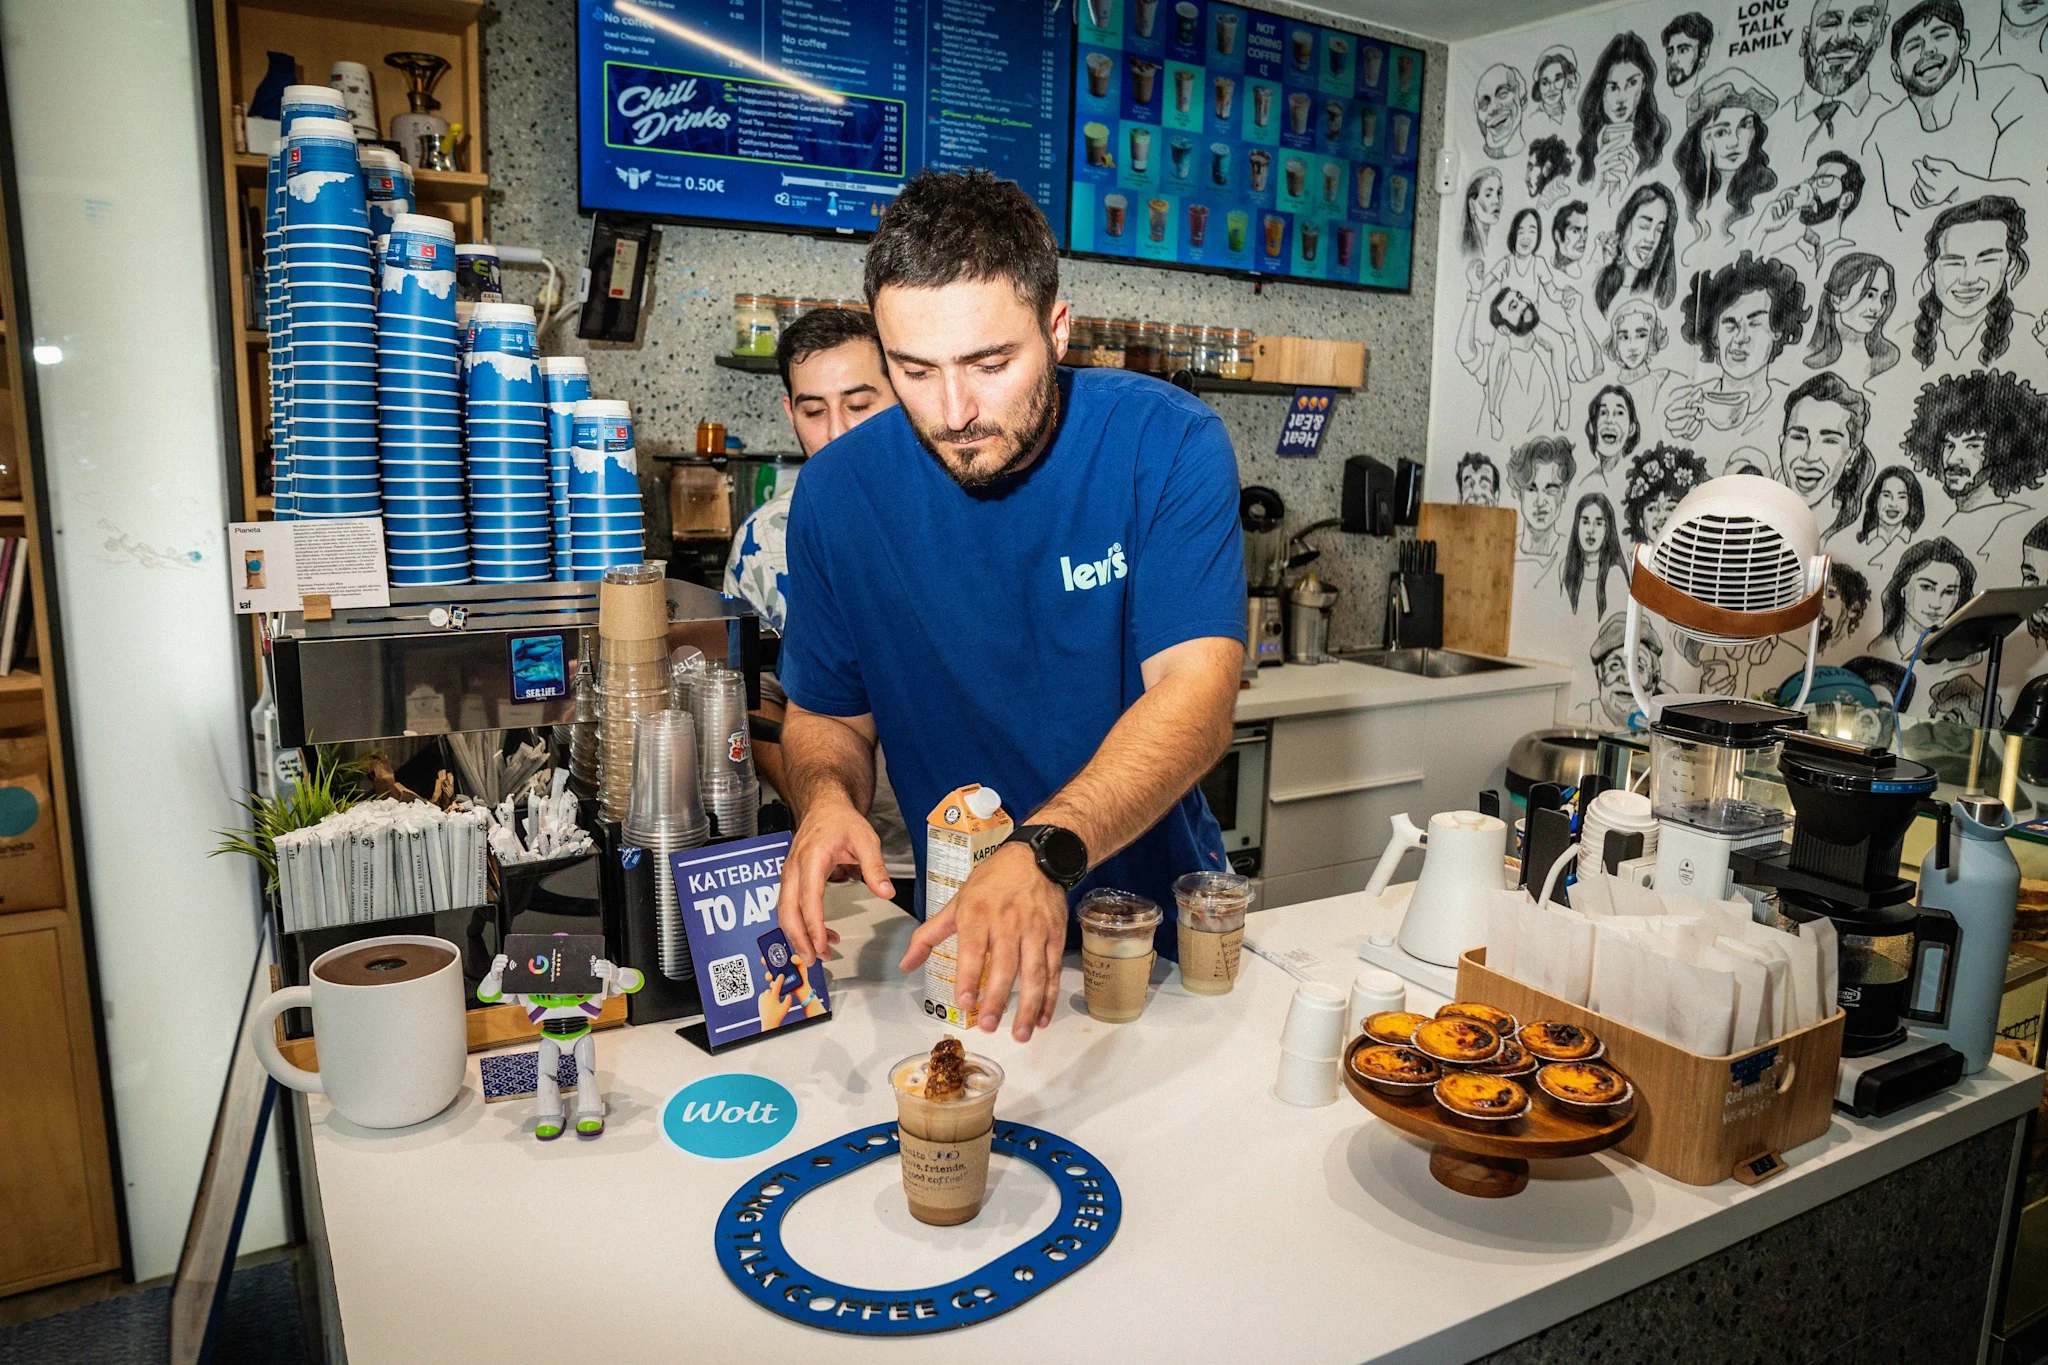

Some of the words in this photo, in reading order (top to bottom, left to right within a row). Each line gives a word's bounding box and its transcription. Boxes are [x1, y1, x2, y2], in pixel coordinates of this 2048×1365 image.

[782, 9, 798, 17] Filter
[799, 11, 819, 20] coffee
[1738, 0, 1789, 20] LONG
[604, 12, 620, 24] No
[1739, 12, 1786, 37] TALK
[782, 20, 798, 29] Filter
[799, 23, 818, 32] coffee
[954, 26, 970, 34] Latte
[1256, 22, 1276, 36] NOT
[604, 30, 619, 40] Iced
[620, 32, 656, 44] Chocolate
[782, 34, 797, 45] No
[797, 37, 828, 50] coffee
[942, 32, 963, 42] Spanish
[963, 36, 978, 44] Latte
[1248, 33, 1282, 51] BORING
[1728, 28, 1794, 57] FAMILY
[604, 43, 630, 54] Orange
[630, 47, 650, 56] Juice
[782, 45, 794, 54] Tea
[941, 40, 959, 49] Salted
[959, 43, 982, 53] Caramel
[993, 49, 1008, 57] Latte
[1247, 46, 1282, 64] COFFEE
[952, 58, 973, 68] Banana
[988, 64, 1003, 72] Latte
[961, 52, 984, 61] Caramel
[995, 57, 1010, 65] Latte
[794, 58, 826, 70] Chocolate
[826, 63, 866, 75] Marshmallow
[966, 68, 981, 77] Latte
[941, 73, 969, 83] Raspberry
[969, 77, 984, 85] Latte
[738, 85, 778, 98] Frappuccino
[778, 91, 800, 101] Mango
[976, 86, 991, 94] Latte
[617, 78, 698, 118] Chill
[977, 93, 993, 102] Latte
[738, 96, 778, 108] Frappuccino
[778, 100, 799, 110] Vanilla
[799, 103, 825, 113] Caramel
[825, 106, 838, 116] Pop
[838, 108, 854, 117] Corn
[940, 97, 969, 107] Chocolate
[996, 105, 1011, 113] Latte
[738, 106, 778, 118] Frappuccino
[778, 111, 799, 121] Coffee
[801, 114, 812, 122] and
[812, 115, 845, 127] Strawberry
[738, 117, 753, 126] Iced
[753, 118, 765, 127] Tea
[632, 105, 732, 145] Drinks
[940, 118, 965, 128] Premium
[965, 121, 986, 131] Matcha
[738, 127, 757, 138] Funky
[758, 129, 794, 141] Lemonades
[940, 134, 960, 144] Mango
[959, 136, 980, 145] Matcha
[954, 128, 975, 138] Matcha
[975, 131, 989, 139] Latte
[738, 137, 769, 149] California
[770, 141, 800, 151] Smoothie
[940, 141, 967, 152] Raspberry
[967, 145, 988, 154] Matcha
[738, 148, 774, 160] BerryBomb
[774, 151, 804, 162] Smoothie
[940, 149, 952, 157] Blue
[952, 151, 973, 160] Matcha
[684, 176, 726, 193] 0.50€
[1282, 430, 1319, 448] Heat
[239, 600, 252, 610] taf
[525, 688, 541, 698] SEA
[415, 853, 423, 879] REUSABLE
[689, 855, 786, 895] ΚΑΤΕΒΑΣΕ
[693, 894, 738, 936] ΤΟ
[682, 1100, 780, 1124] Wolt
[924, 1163, 967, 1174] friends,
[843, 1129, 899, 1154] LO
[1050, 1149, 1112, 1232] COFFEE
[736, 1171, 801, 1224] LONG
[732, 1228, 790, 1289] TALK
[783, 1284, 940, 1322] COFFEE
